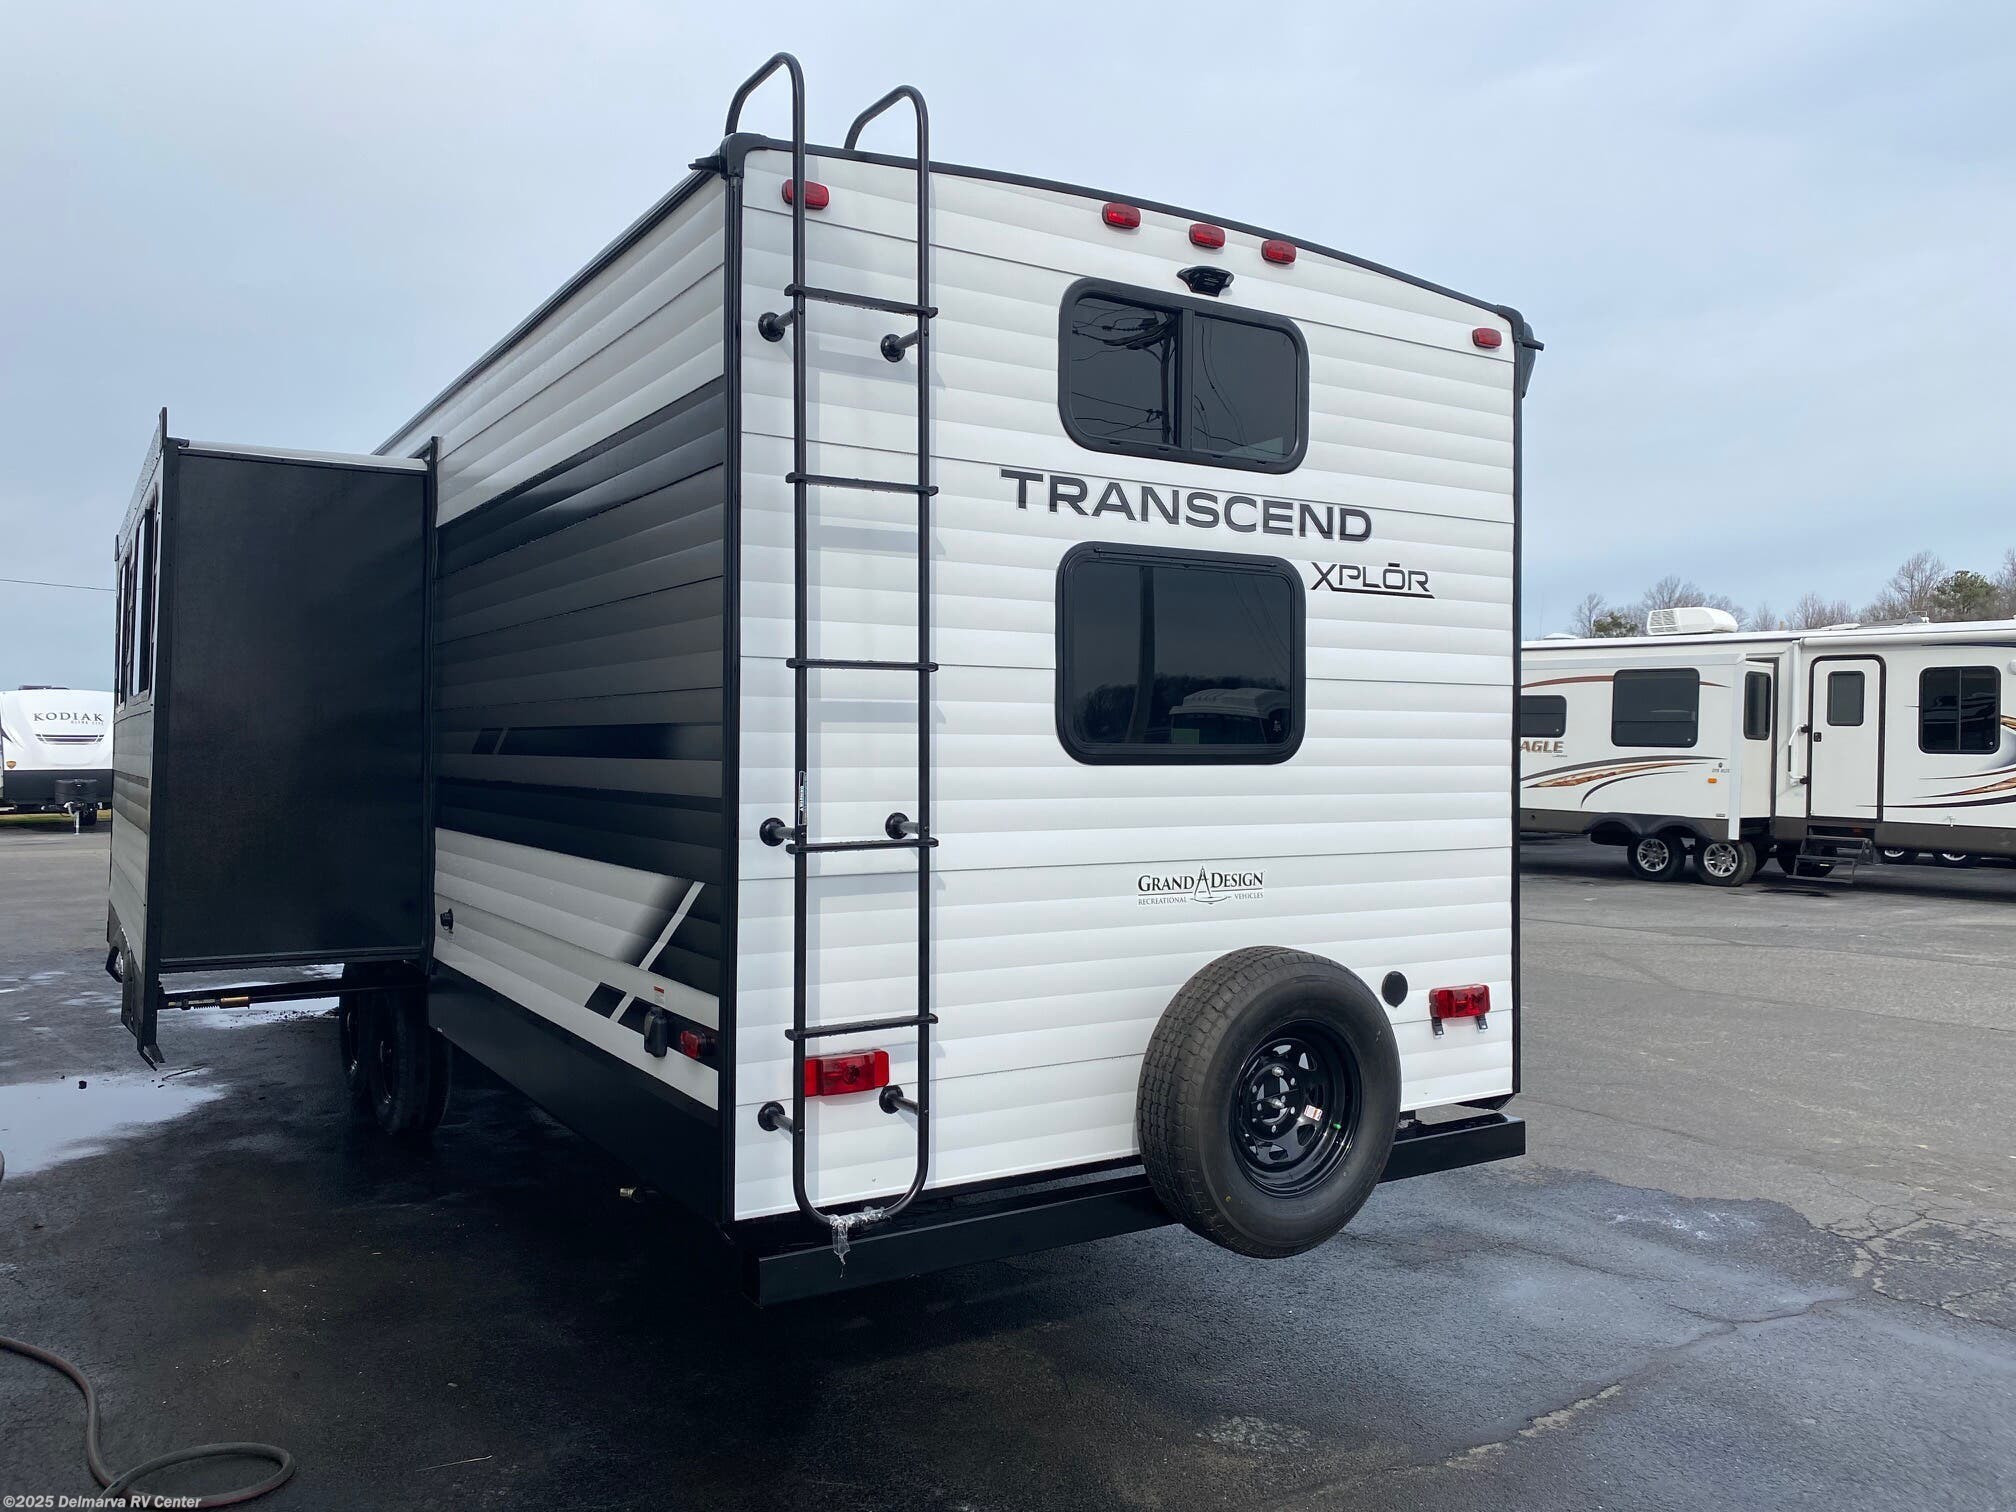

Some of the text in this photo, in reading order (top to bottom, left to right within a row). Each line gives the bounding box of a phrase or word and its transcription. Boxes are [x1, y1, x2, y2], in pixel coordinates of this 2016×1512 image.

[1001, 468, 1372, 542] TRANSCEND
[33, 712, 104, 722] KODIAK
[1520, 740, 1564, 753] AGLE
[1138, 872, 1264, 892] GRAND DESIGN
[1138, 891, 1264, 906] RECREATIONAL VEHICLES
